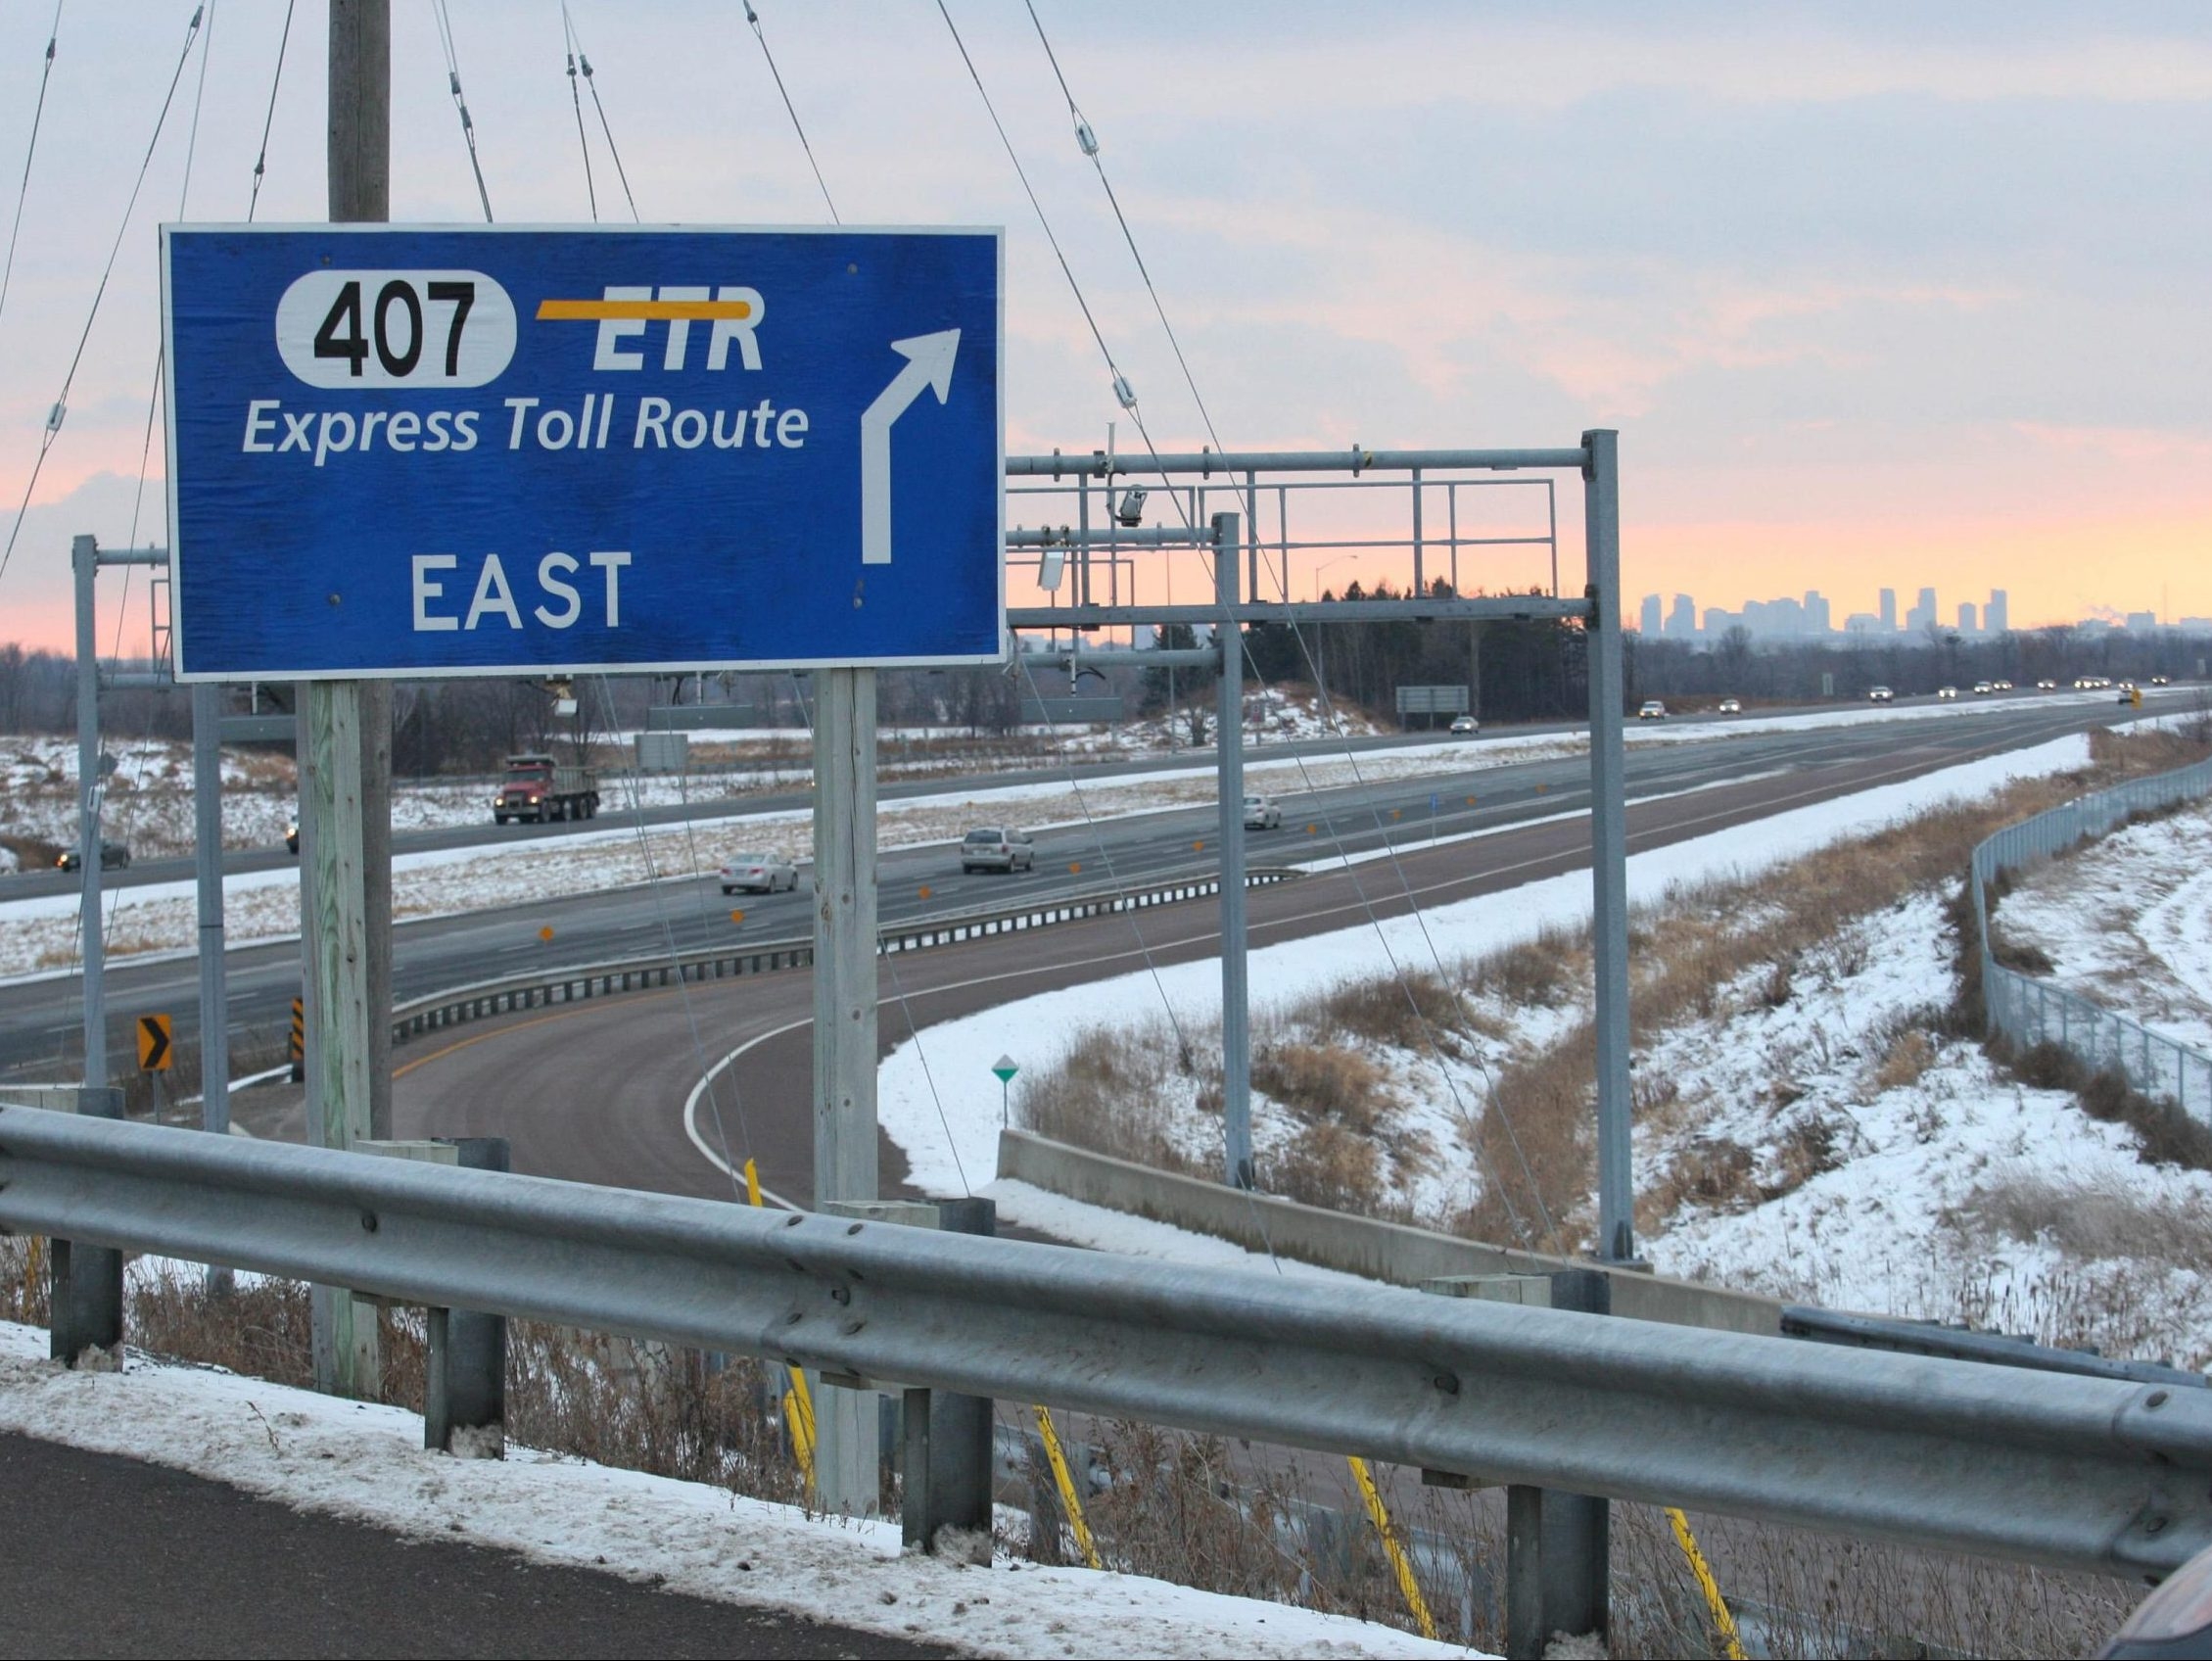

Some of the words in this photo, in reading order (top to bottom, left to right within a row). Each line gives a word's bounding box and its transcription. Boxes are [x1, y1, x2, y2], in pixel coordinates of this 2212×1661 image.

[313, 280, 475, 378] 407
[592, 286, 766, 371] ETR
[243, 400, 480, 467] Express
[504, 394, 614, 450] Toll
[634, 397, 810, 450] Route
[412, 551, 633, 631] EAST
